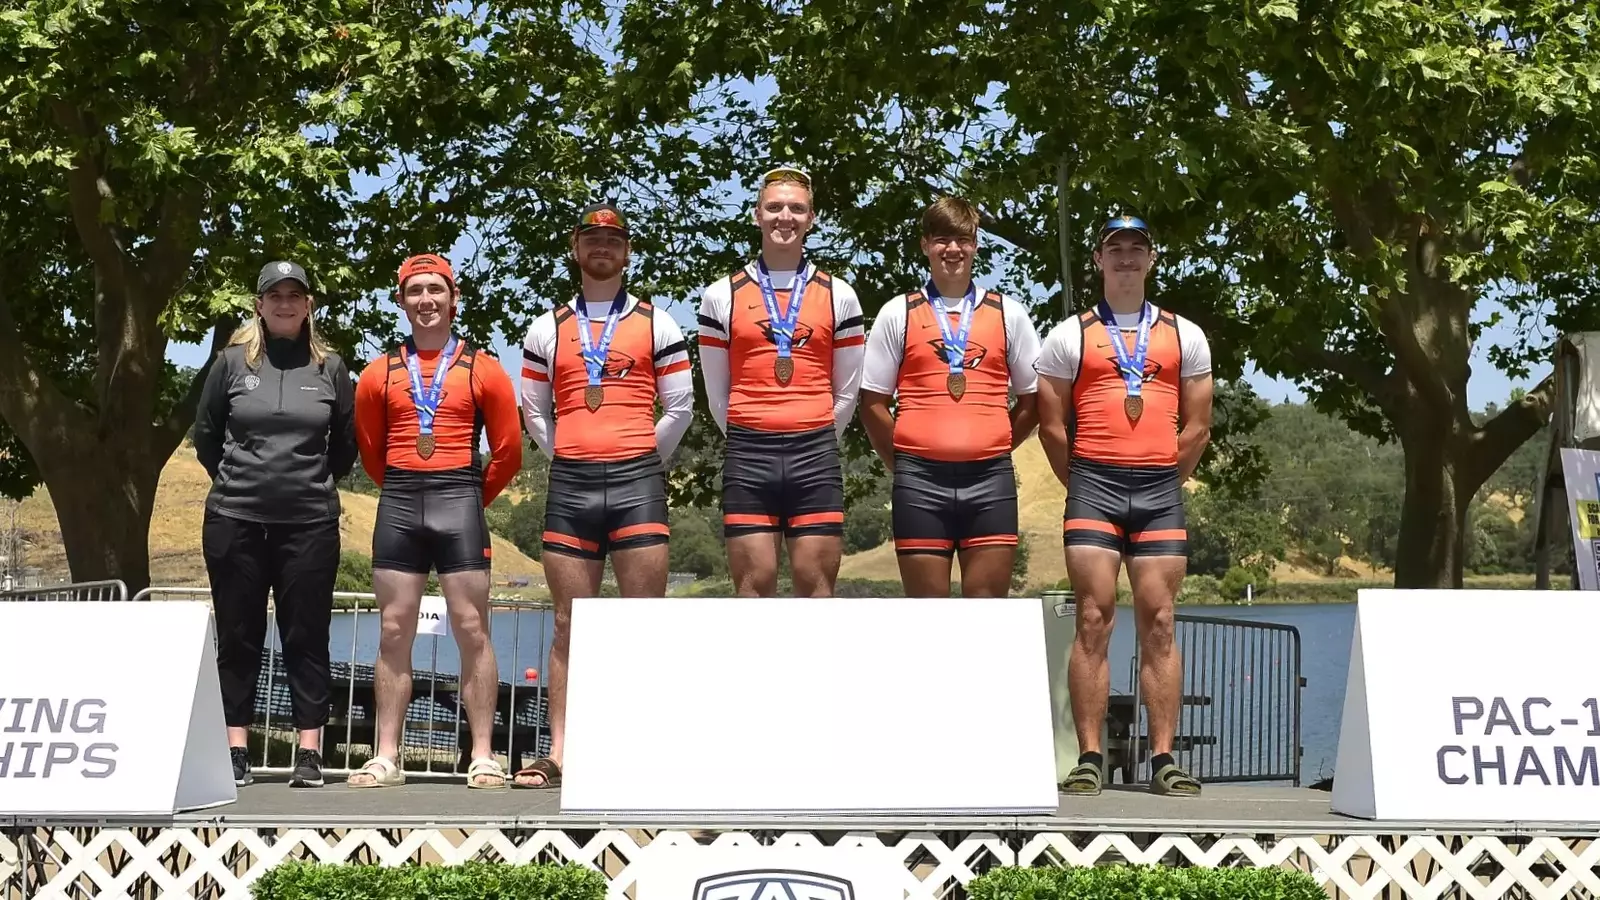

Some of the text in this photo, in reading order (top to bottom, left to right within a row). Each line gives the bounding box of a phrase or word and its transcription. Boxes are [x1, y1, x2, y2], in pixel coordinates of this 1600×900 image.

[0, 698, 107, 733] ING
[1452, 696, 1600, 736] PAC-1
[1437, 745, 1600, 786] CHAM
